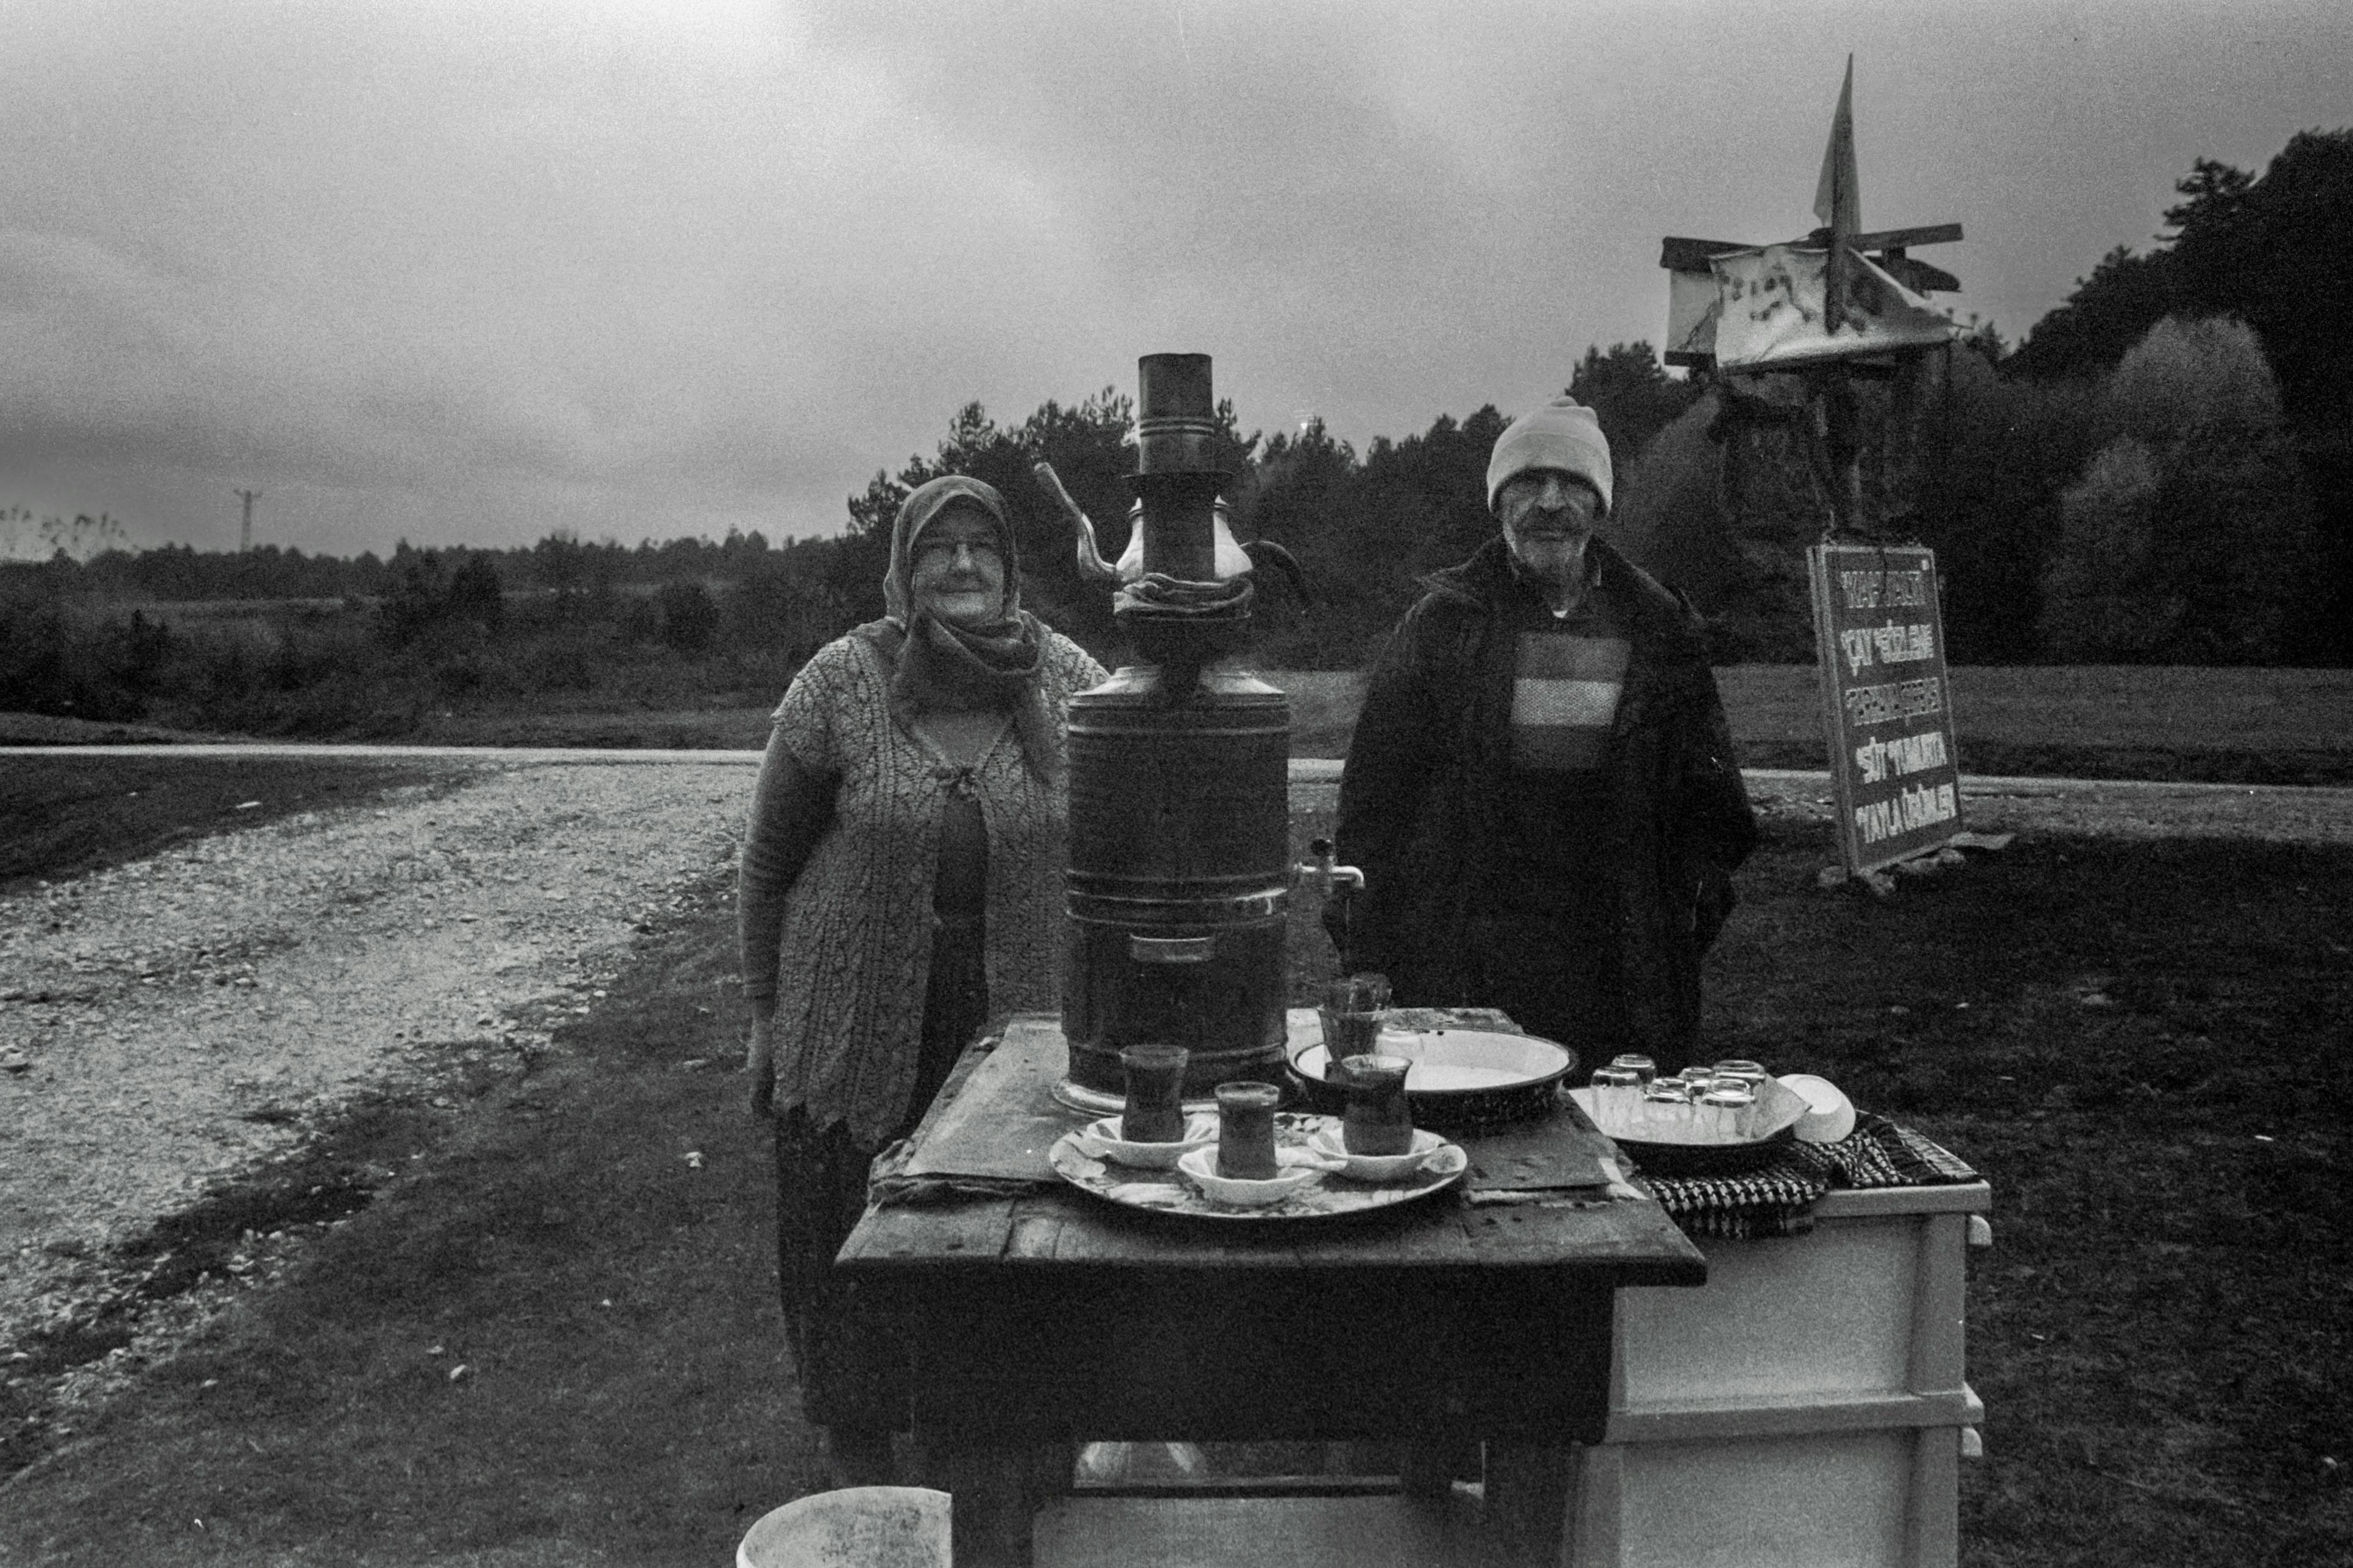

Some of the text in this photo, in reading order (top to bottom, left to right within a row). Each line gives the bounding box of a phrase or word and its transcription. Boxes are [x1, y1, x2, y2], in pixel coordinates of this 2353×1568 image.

[1840, 619, 1934, 677] ÇAY GÖZLEME
[1855, 731, 1947, 784] SÜT YUMURTA
[1855, 798, 1904, 844] YAYLA
